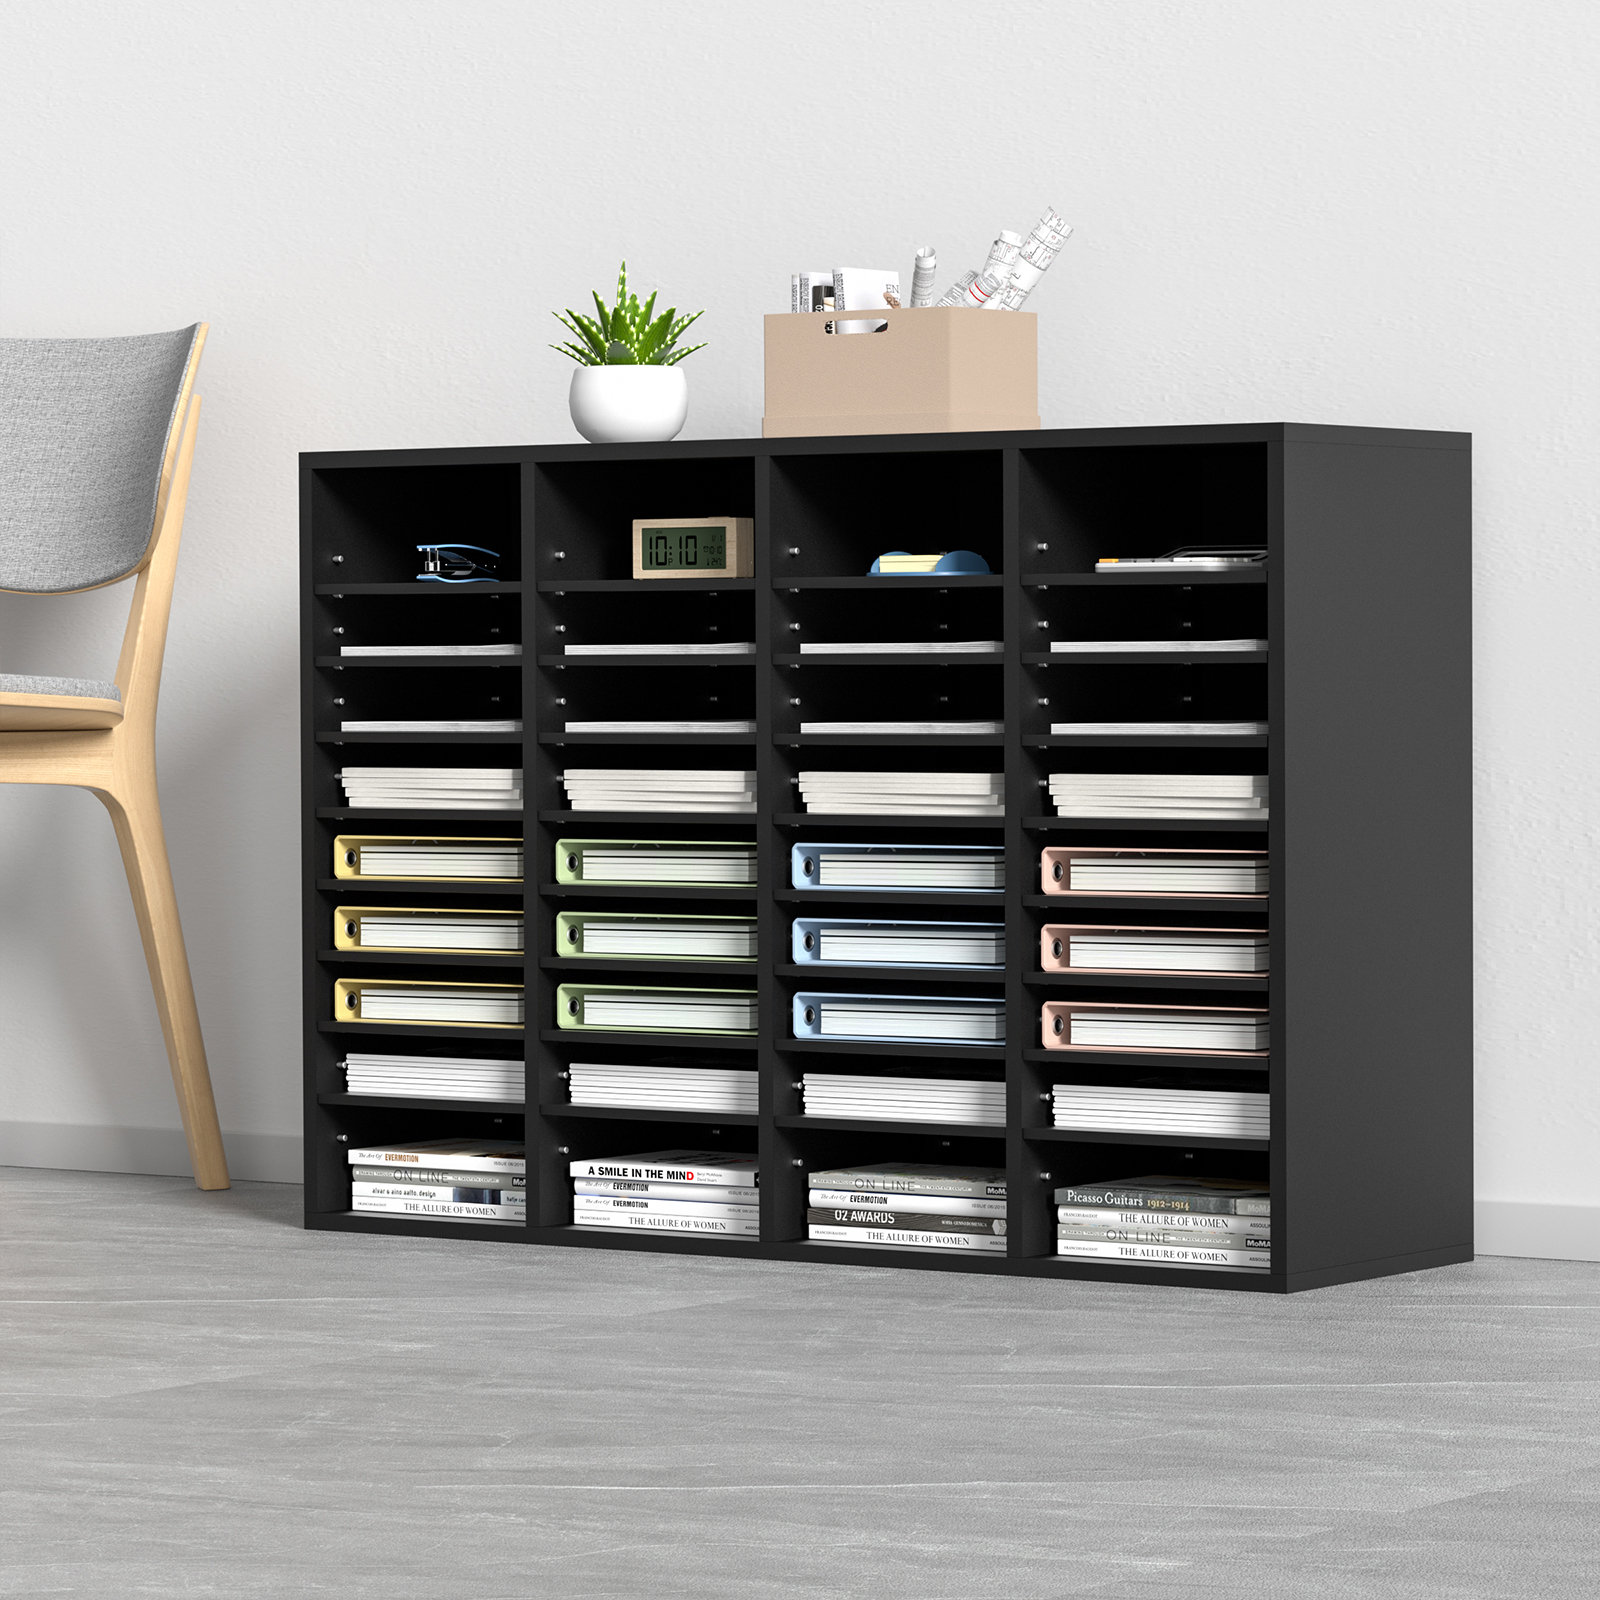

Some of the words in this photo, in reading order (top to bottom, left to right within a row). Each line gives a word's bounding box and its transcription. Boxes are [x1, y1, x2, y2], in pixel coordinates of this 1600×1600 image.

[649, 535, 697, 566] 10:10
[384, 1153, 419, 1163] EVERMOTION
[394, 1169, 413, 1182] ON
[419, 1170, 449, 1183] LINE
[588, 1166, 595, 1175] A
[598, 1166, 628, 1177] SMILE
[632, 1168, 642, 1178] IN
[645, 1169, 663, 1179] THE
[667, 1171, 694, 1181] MIND
[613, 1182, 649, 1192] EVERMOTION
[854, 1178, 875, 1190] ON
[882, 1180, 915, 1191] LINE
[419, 1190, 436, 1198] design
[850, 1195, 888, 1205] EVERMOTION
[1067, 1190, 1102, 1203] Picasso
[1104, 1192, 1143, 1206] Guitars
[404, 1203, 420, 1211] THE
[422, 1204, 452, 1213] ALLURE
[453, 1206, 463, 1214] OF
[465, 1207, 496, 1216] WOMEN
[613, 1200, 648, 1208] EVERMOTION
[628, 1216, 645, 1225] THE
[647, 1218, 678, 1227] ALLURE
[681, 1220, 692, 1228] OF
[693, 1221, 726, 1230] WOMEN
[850, 1210, 895, 1224] AWARDS
[1118, 1213, 1138, 1223] THE
[1140, 1214, 1175, 1225] ALLURE
[1178, 1217, 1191, 1226] OF
[1192, 1217, 1228, 1228] WOMEN
[866, 1232, 884, 1240] THE
[886, 1233, 920, 1242] ALLURE
[922, 1235, 933, 1243] OF
[935, 1236, 969, 1245] WOMEN
[1106, 1230, 1128, 1240] ON
[1136, 1231, 1170, 1243] LINE
[1118, 1247, 1138, 1256] THE
[1140, 1248, 1175, 1259] ALLURE
[1177, 1251, 1190, 1259] OF
[1191, 1252, 1228, 1261] WOMEN
